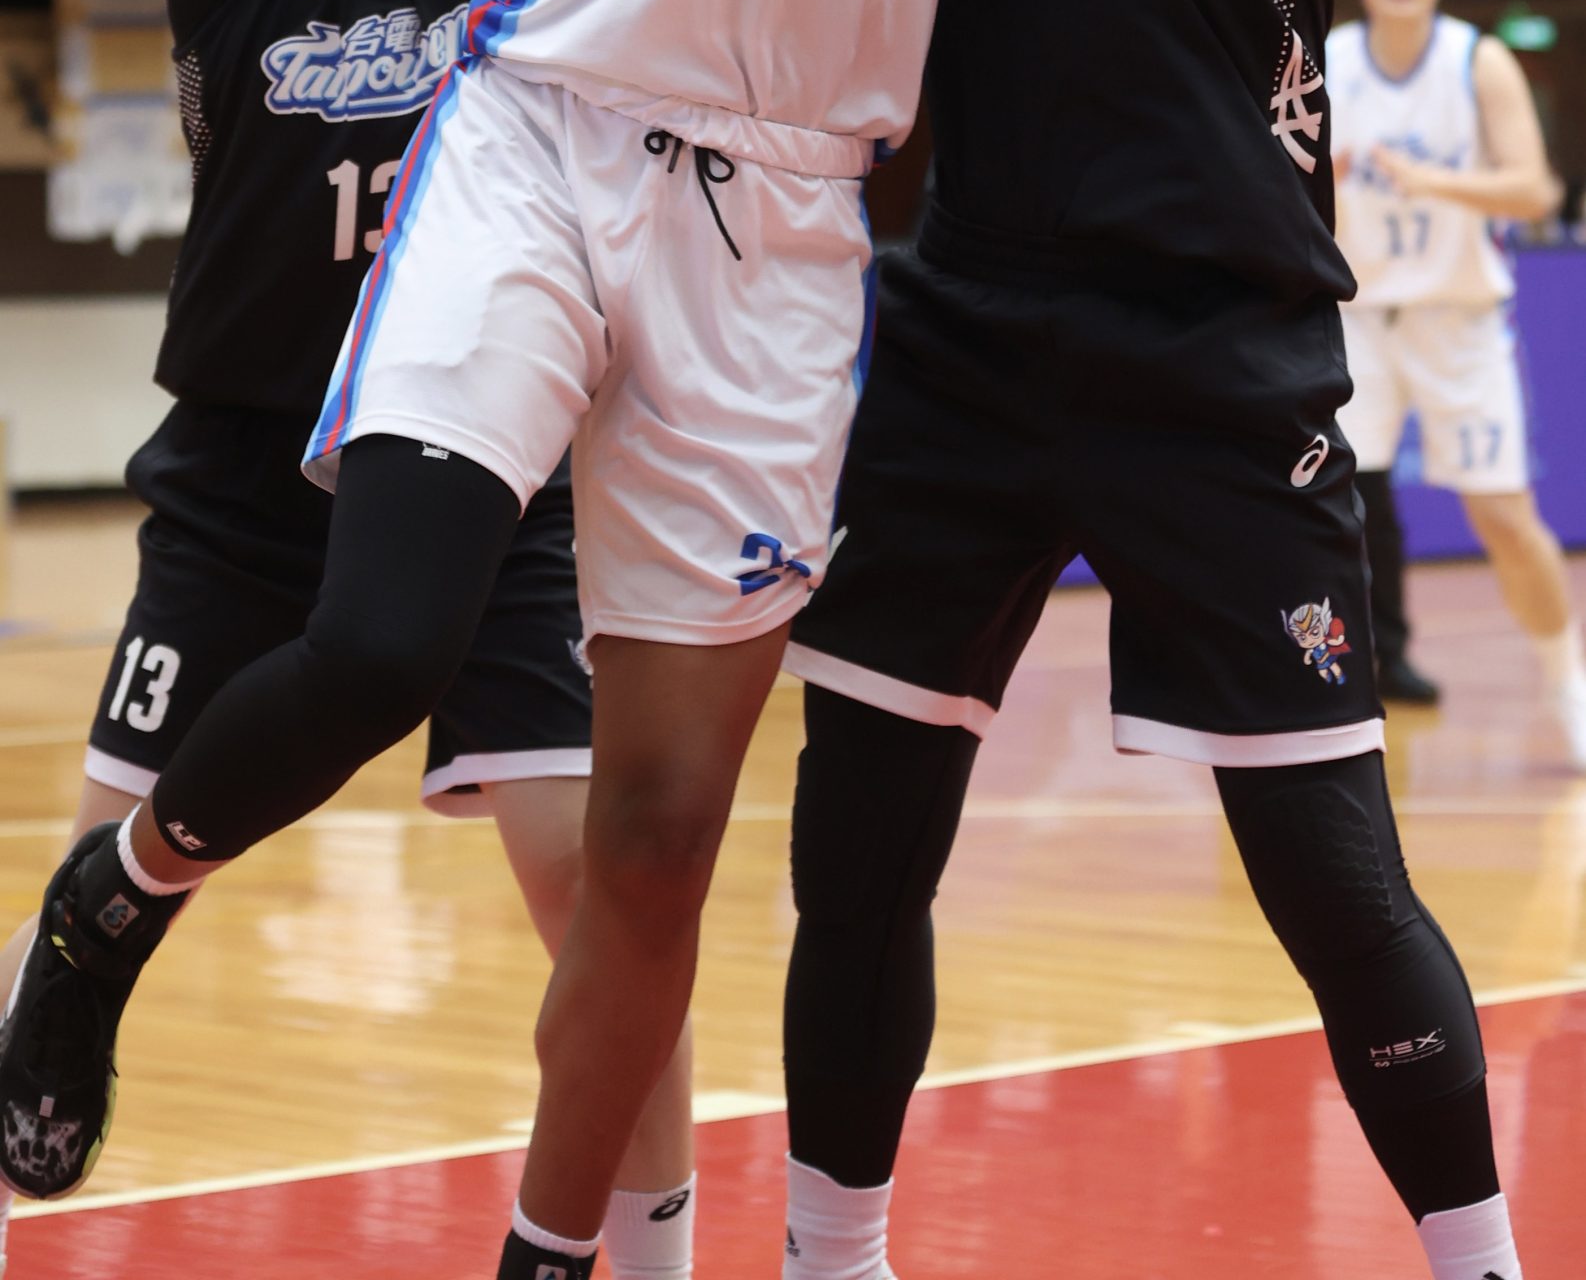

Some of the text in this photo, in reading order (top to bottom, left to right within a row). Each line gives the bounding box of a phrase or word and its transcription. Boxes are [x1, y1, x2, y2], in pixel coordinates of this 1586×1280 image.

[346, 16, 421, 57] 台電
[1385, 210, 1431, 257] 17
[1460, 422, 1503, 470] 17
[735, 533, 812, 596] 2
[108, 635, 181, 733] 13
